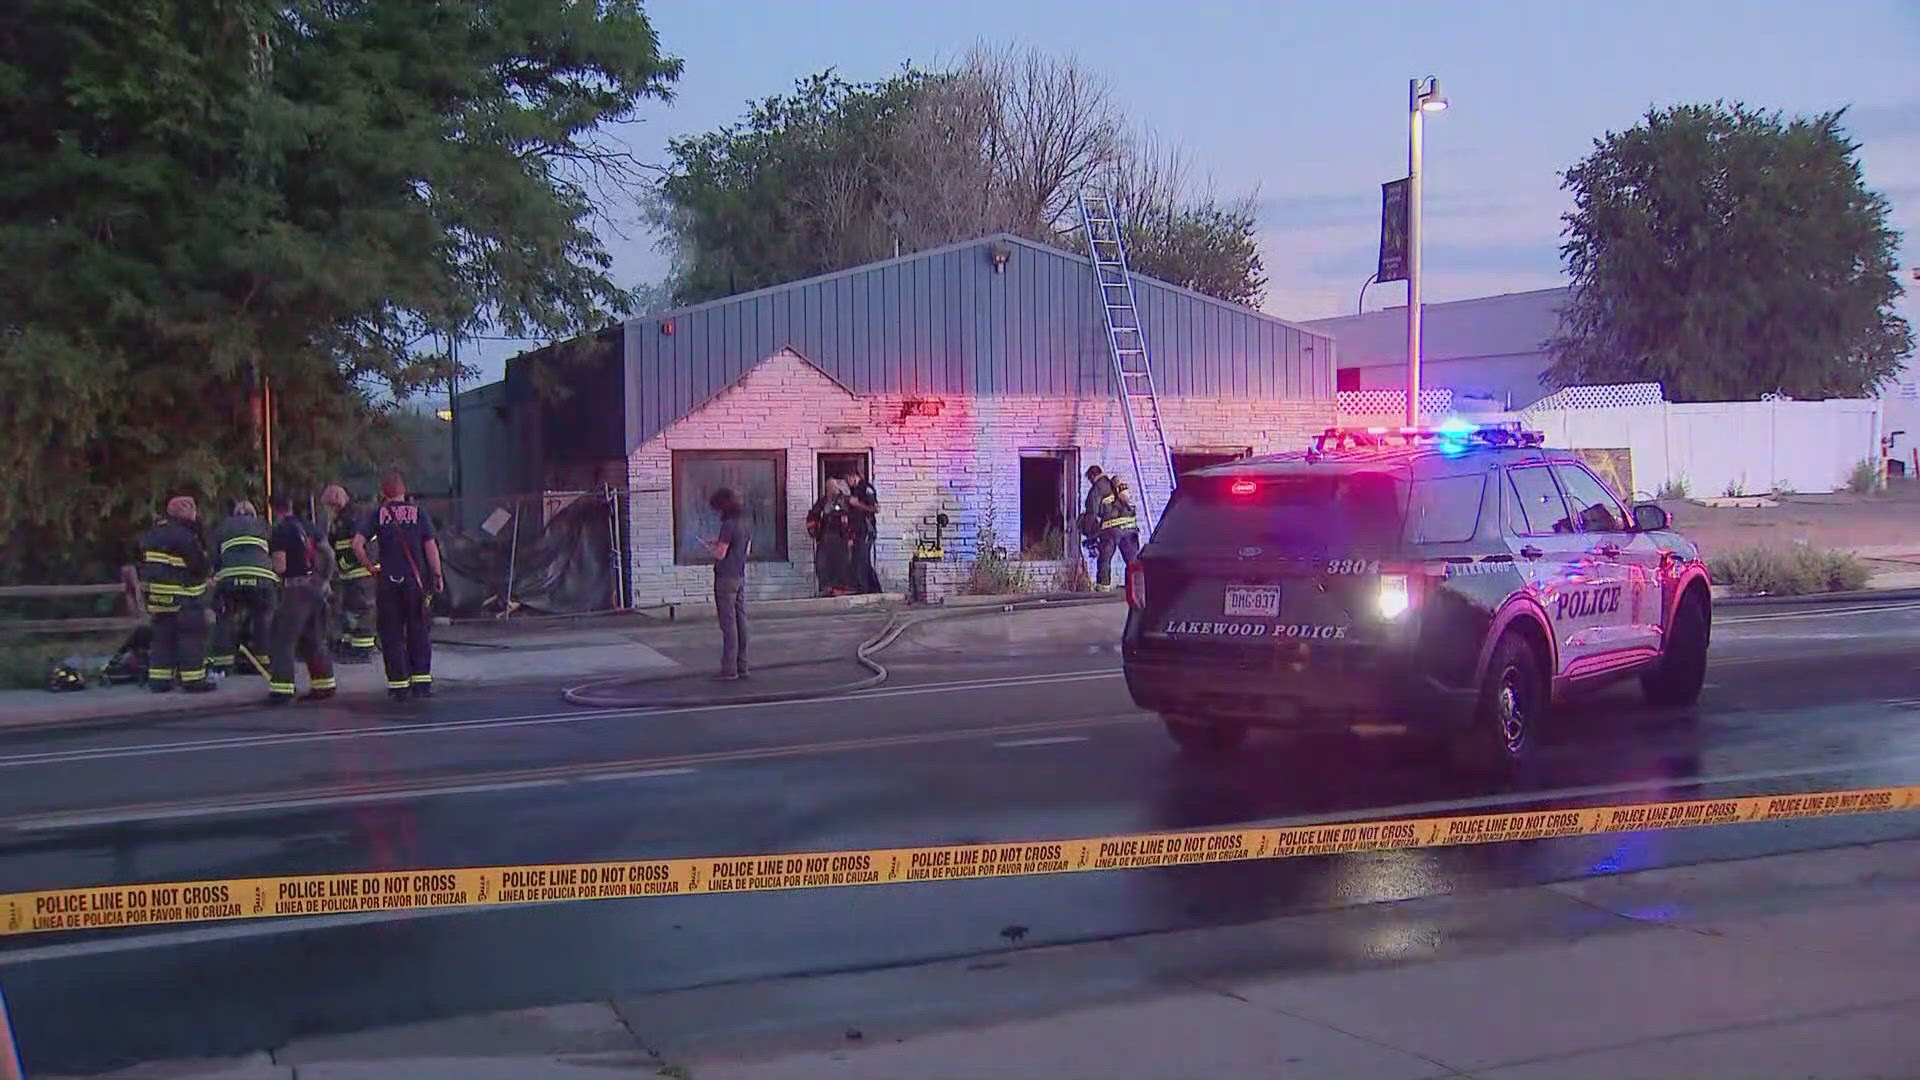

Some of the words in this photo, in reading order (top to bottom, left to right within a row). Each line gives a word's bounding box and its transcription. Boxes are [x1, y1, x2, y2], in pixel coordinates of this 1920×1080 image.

[1327, 558, 1379, 576] 3304
[1455, 563, 1510, 576] LAKEWOOD
[1556, 586, 1621, 621] POLICE
[1167, 620, 1265, 637] LAKEWOOD
[1272, 624, 1346, 639] POLICE
[1450, 820, 1483, 834] POLICE
[1486, 818, 1507, 832] LINE
[1510, 816, 1523, 830] DO
[1525, 815, 1546, 829] NOT
[1547, 813, 1579, 827] CROSS
[1612, 810, 1645, 823] POLICE
[1647, 808, 1667, 821] LINE
[1670, 807, 1683, 819] DO
[1685, 806, 1705, 818] NOT
[1707, 803, 1737, 816] CROSS
[1279, 831, 1314, 845] POLICE
[1317, 829, 1340, 844] LINE
[1343, 828, 1357, 841] DO
[1359, 826, 1379, 840] NOT
[1381, 823, 1415, 839] CROSS
[912, 852, 950, 867] POLICE
[953, 850, 979, 865] LINE
[982, 849, 997, 863] DO
[1000, 847, 1022, 862] NOT
[1026, 845, 1062, 861] CROSS
[1100, 841, 1136, 857] POLICE
[1140, 840, 1163, 855] LINE
[1167, 838, 1181, 852] DO
[1184, 837, 1205, 852] NOT
[1208, 835, 1242, 850] CROSS
[502, 870, 546, 888] POLICE
[550, 869, 577, 886] LINE
[581, 868, 597, 884] DO
[601, 867, 626, 883] NOT
[630, 865, 669, 882] CROSS
[713, 862, 753, 877] POLICE
[757, 860, 783, 875] LINE
[787, 859, 802, 873] DO
[806, 857, 830, 872] NOT
[832, 855, 870, 871] CROSS
[906, 869, 931, 880] LINEA
[933, 868, 944, 878] DE
[945, 866, 976, 877] POLICIA
[978, 865, 995, 875] POR
[997, 863, 1021, 875] FAVOR
[1024, 862, 1035, 873] NO
[1037, 860, 1068, 872] CRUZAR
[279, 882, 325, 899] POLICE
[329, 879, 358, 896] LINE
[362, 878, 380, 894] DO
[385, 876, 410, 893] NOT
[414, 874, 456, 892] CROSS
[499, 889, 525, 902] LINEA
[528, 888, 540, 900] DE
[542, 886, 576, 899] POLICIA
[578, 885, 597, 897] POR
[599, 884, 627, 896] FAVOR
[629, 883, 642, 894] NO
[644, 881, 679, 894] CRUZAR
[708, 879, 734, 891] LINEA
[736, 878, 747, 890] DE
[749, 876, 781, 889] POLICIA
[784, 874, 801, 886] POR
[803, 873, 830, 886] FAVOR
[832, 873, 844, 884] NO
[846, 871, 879, 883] CRUZAR
[36, 894, 87, 913] POLICE
[92, 892, 124, 910] LINE
[128, 890, 146, 909] DO
[152, 888, 179, 906] NOT
[183, 885, 229, 904] CROSS
[275, 901, 303, 913] LINEA
[306, 900, 319, 912] DE
[321, 898, 358, 911] POLICIA
[360, 897, 379, 909] POR
[382, 895, 412, 907] FAVOR
[415, 894, 428, 905] NO
[431, 892, 467, 905] CRUZAR
[32, 915, 64, 930] LINEA
[67, 914, 80, 927] DE
[83, 911, 124, 926] POLICIA
[126, 909, 147, 923] POR
[150, 907, 182, 921] FAVOR
[185, 905, 199, 919] NO
[202, 903, 242, 917] CRUZAR
